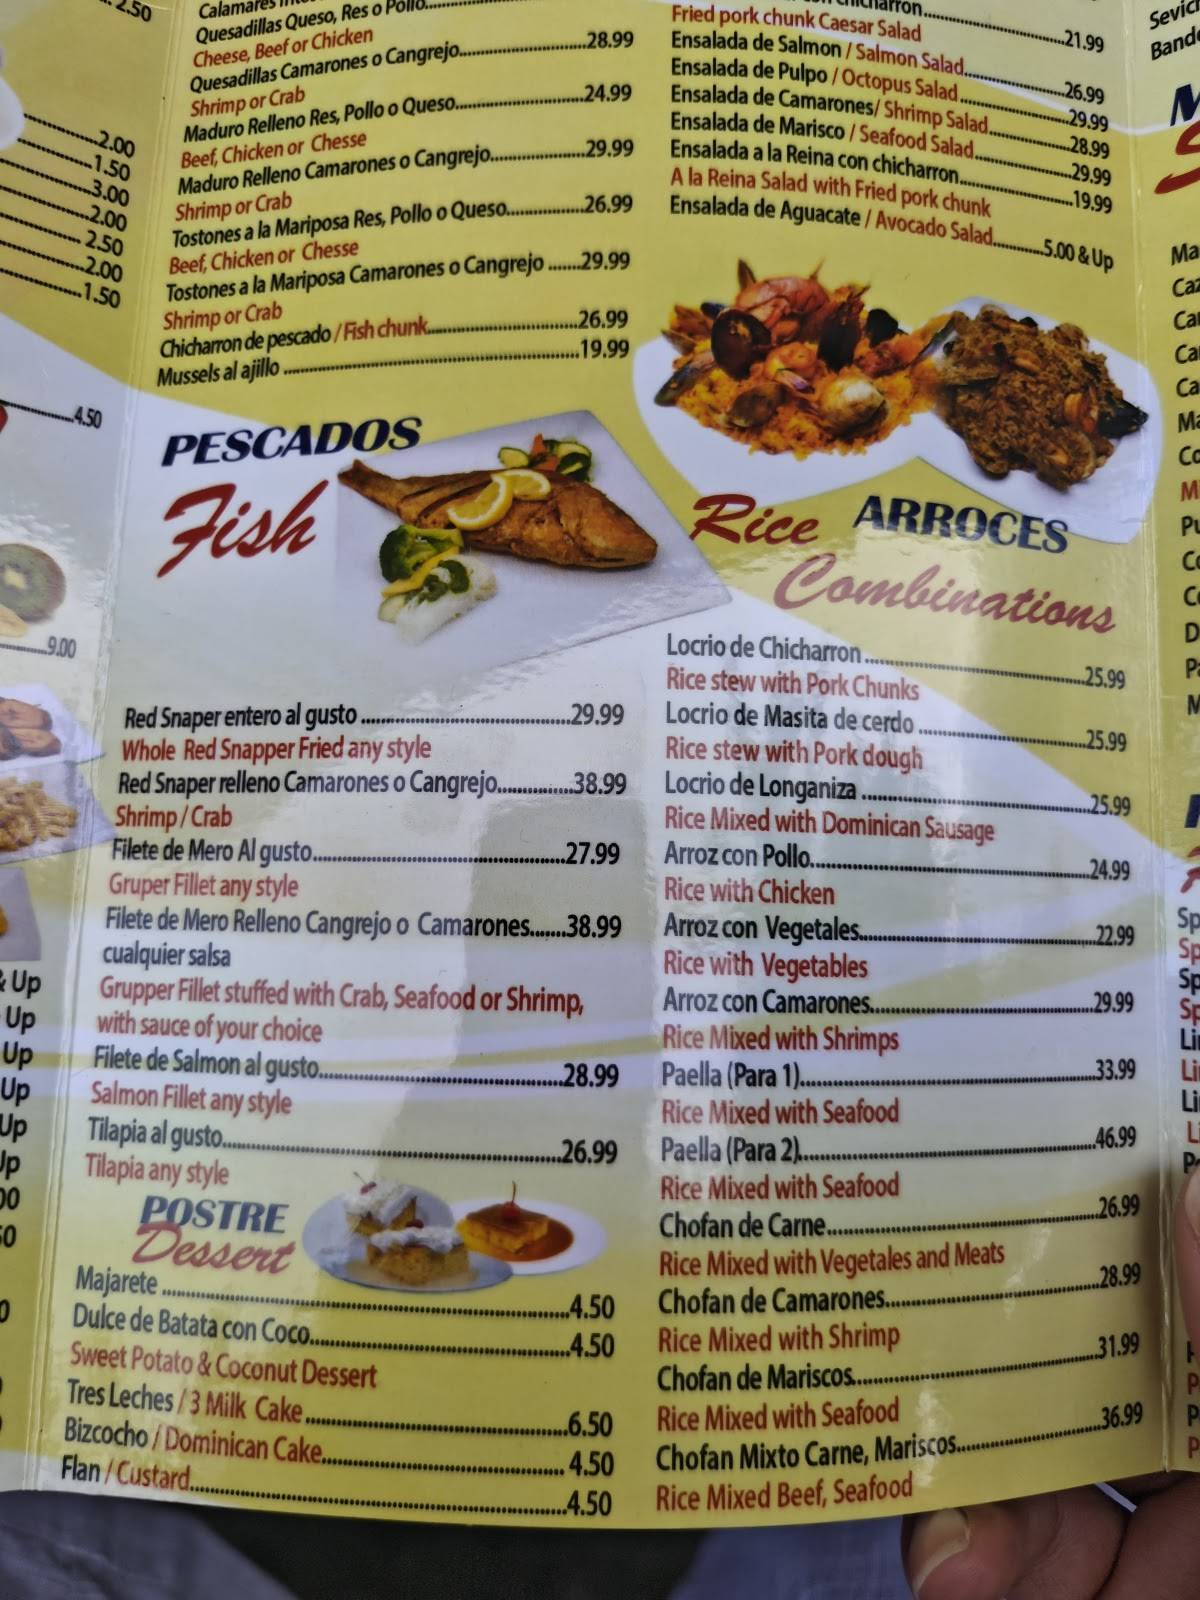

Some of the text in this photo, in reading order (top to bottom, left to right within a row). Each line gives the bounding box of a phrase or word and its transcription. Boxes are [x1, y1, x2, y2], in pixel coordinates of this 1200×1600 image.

[672, 4, 922, 43] Fried pork chunk Caesar Salad
[1065, 30, 1104, 53] 21.99
[190, 31, 634, 94] Quesadillas Camarones o Cangrejo 28.99
[193, 28, 374, 68] Cheese, Beef or Chicken
[184, 84, 632, 143] Maduro Relleno Res, Pollo o Queso 24.99
[99, 130, 135, 160] 2.00
[94, 154, 132, 184] 1.50
[671, 139, 1112, 214] Ensalada a la Reina con chicharron 19.99
[92, 178, 129, 209] 3.00
[671, 166, 992, 219] A la Reina Salad with Fried pork chunk
[90, 204, 128, 234] 2.00
[174, 194, 633, 249] Tostones a la Mariposa Res, Pollo o Queso 26.99
[86, 229, 125, 259] 2.50
[85, 254, 123, 285] 2.00
[85, 280, 121, 308] 1.50
[74, 406, 102, 429] 4.50
[161, 416, 423, 467] PESCADOS
[156, 479, 329, 579] Fish
[689, 493, 1069, 553] Rice ARROCES
[773, 552, 1116, 634] Combinations
[48, 636, 76, 659] 9.00
[668, 633, 1125, 690] Locrio de Chicharron 25.99
[667, 666, 920, 702] Rice stew with Pork Chunks
[125, 702, 624, 734] Red Snaper entero al gusto 29.99
[122, 735, 432, 766] Whole Red Snapper Fried any style
[666, 805, 996, 847] Rice Mixed with Dominican Sausage
[106, 906, 621, 942] Filete de Mero Relleno Cangrejo o Camarones 38.99
[664, 913, 1135, 947] Arroz con Vegetales 22.99
[103, 941, 232, 971] cualquier salsa
[12, 970, 42, 999] Up
[99, 975, 584, 1020] Grupper Fillet stuffed with Crab, Seafood or Shrimp,
[6, 1005, 36, 1035] Up
[97, 1010, 324, 1045] with sauce of your choice
[2, 1041, 34, 1070] Up
[663, 1058, 1136, 1090] Paella (Para 1) 33.99
[1, 1077, 30, 1107] Up
[140, 1195, 289, 1234] POSTRE
[660, 1195, 1140, 1239] Chofan de Carne 26.99
[131, 1222, 296, 1275] Dessert
[660, 1242, 1006, 1280] Rice Mixed with Vegetales and Meats
[76, 1265, 615, 1319] Majarete 4.50
[73, 1303, 614, 1358] Dulce de Batata con Coco 4.50
[71, 1341, 378, 1389] Sweet Potato & Coconut Dessert
[657, 1472, 913, 1512] Rice Mixed Beef, Seafood
